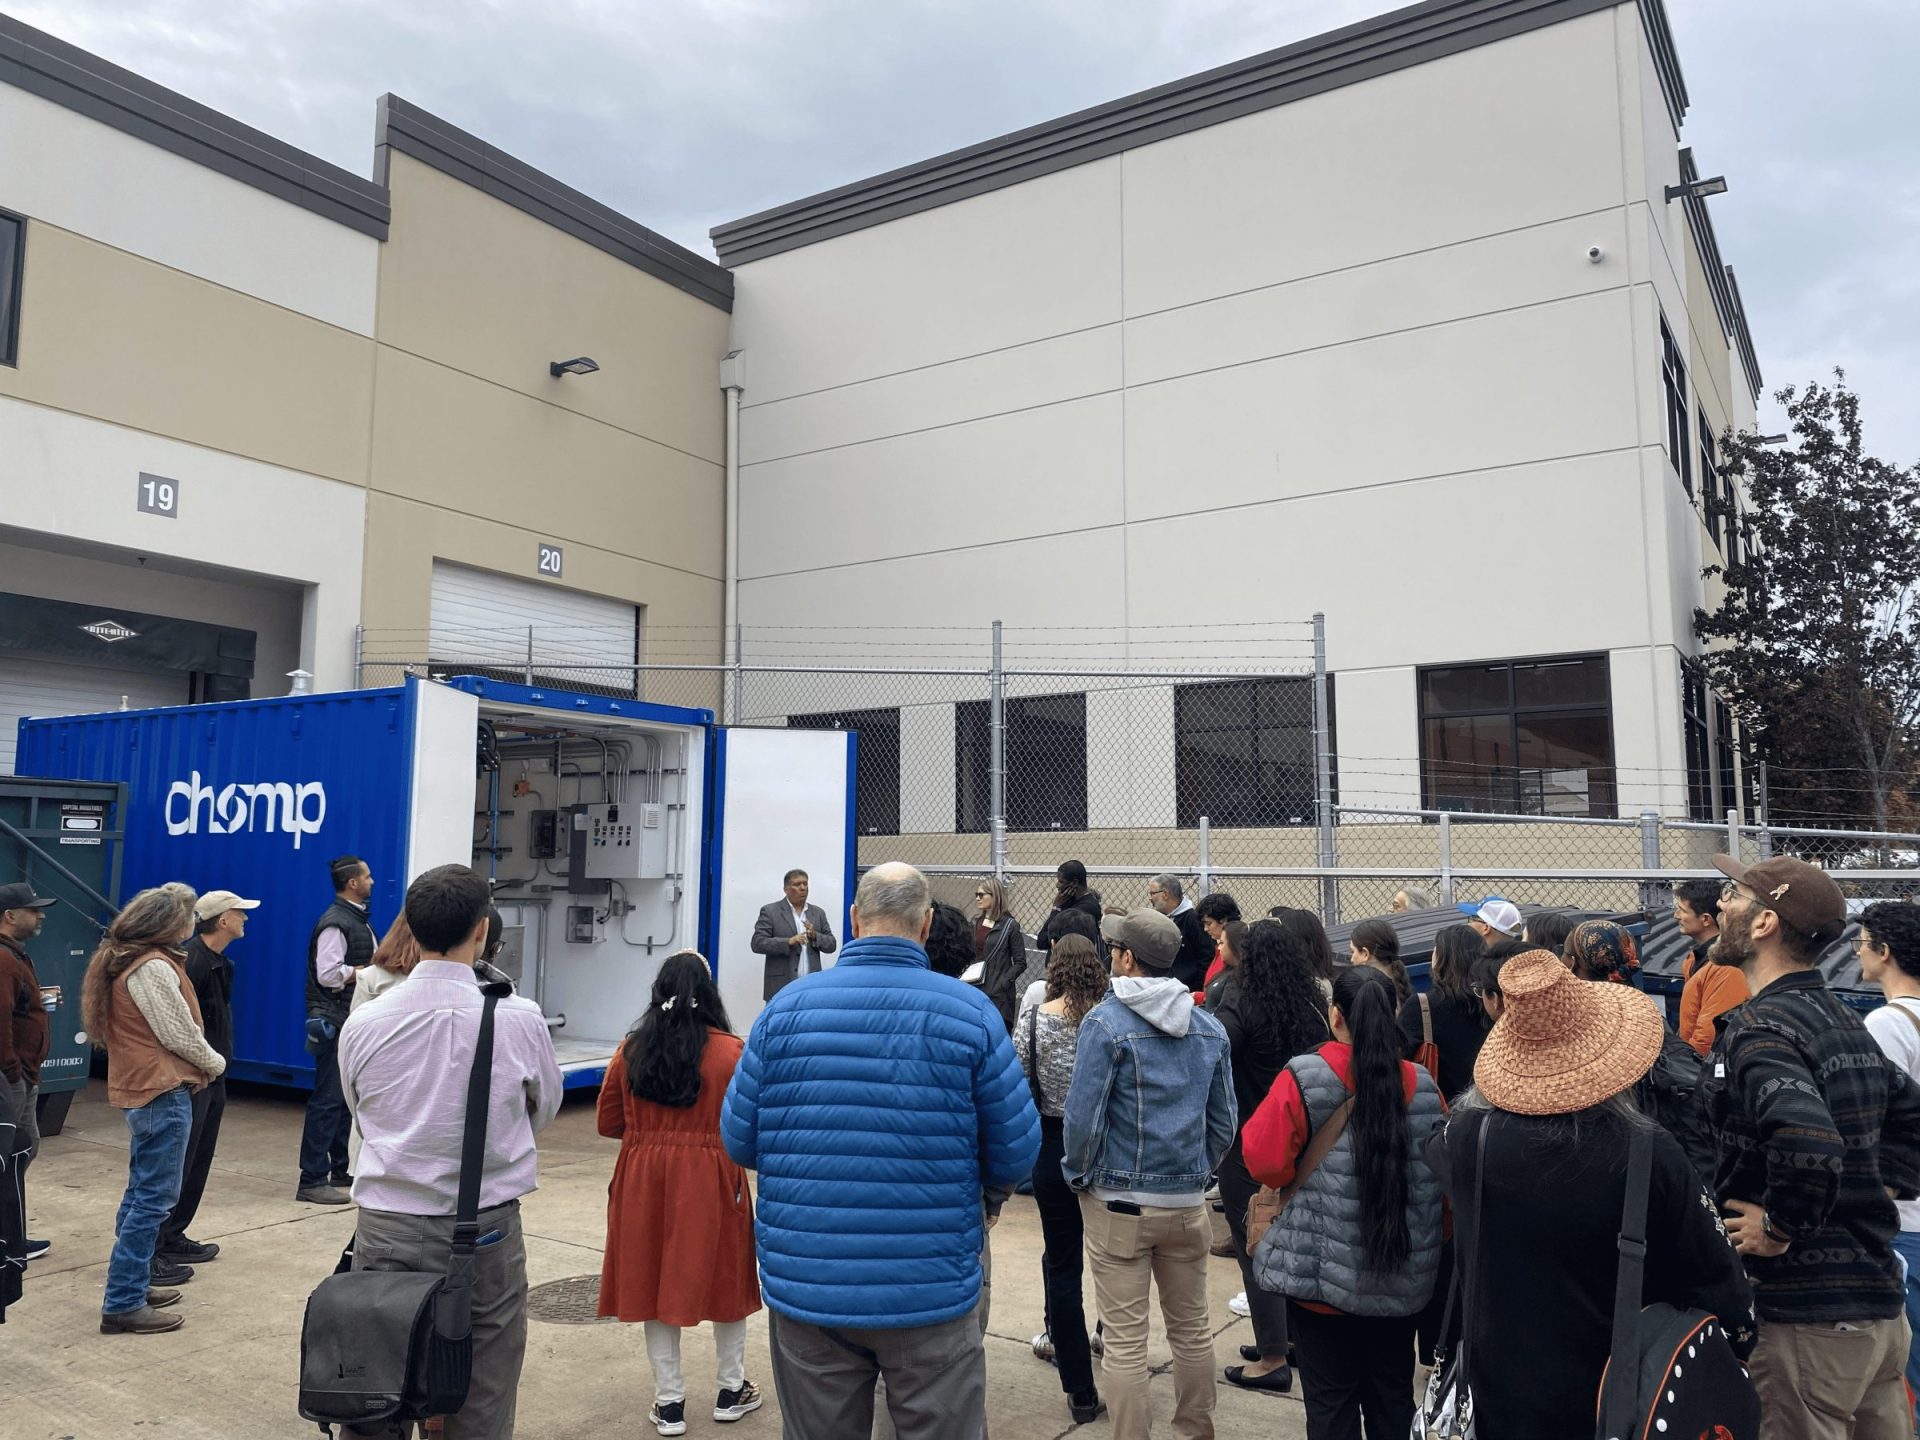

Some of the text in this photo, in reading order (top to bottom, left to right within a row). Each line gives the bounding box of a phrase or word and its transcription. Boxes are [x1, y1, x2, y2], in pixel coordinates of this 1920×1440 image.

[143, 481, 174, 511] 19
[540, 548, 561, 573] 20
[165, 770, 327, 850] chomp
